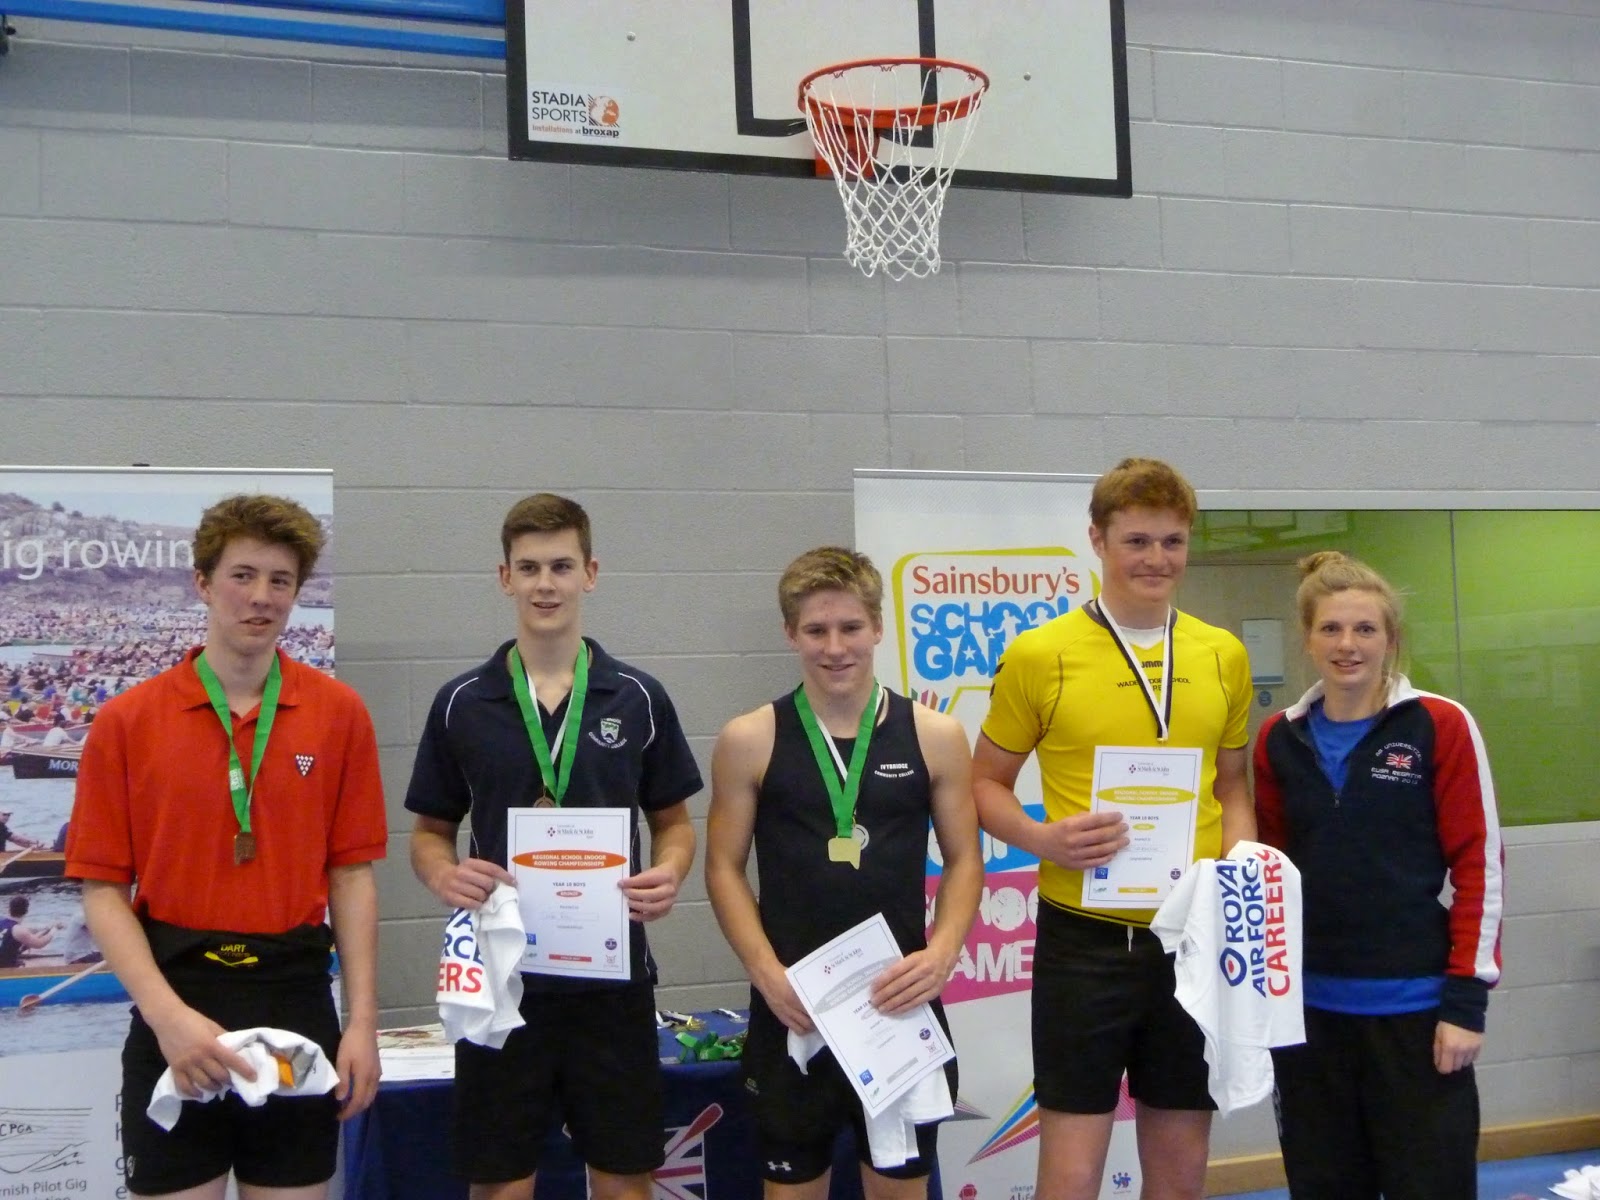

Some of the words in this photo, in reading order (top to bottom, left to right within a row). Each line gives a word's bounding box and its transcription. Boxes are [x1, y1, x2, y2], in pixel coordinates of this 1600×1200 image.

[532, 91, 586, 107] STADIA
[532, 107, 587, 123] SPORTS
[532, 124, 573, 134] installations
[582, 126, 619, 138] broxap
[912, 565, 1080, 600] Sainsbury's
[1242, 858, 1265, 942] FORC
[220, 944, 246, 952] DART
[1250, 945, 1266, 998] AIR
[33, 1181, 61, 1194] Pilot
[65, 1178, 87, 1192] Gig
